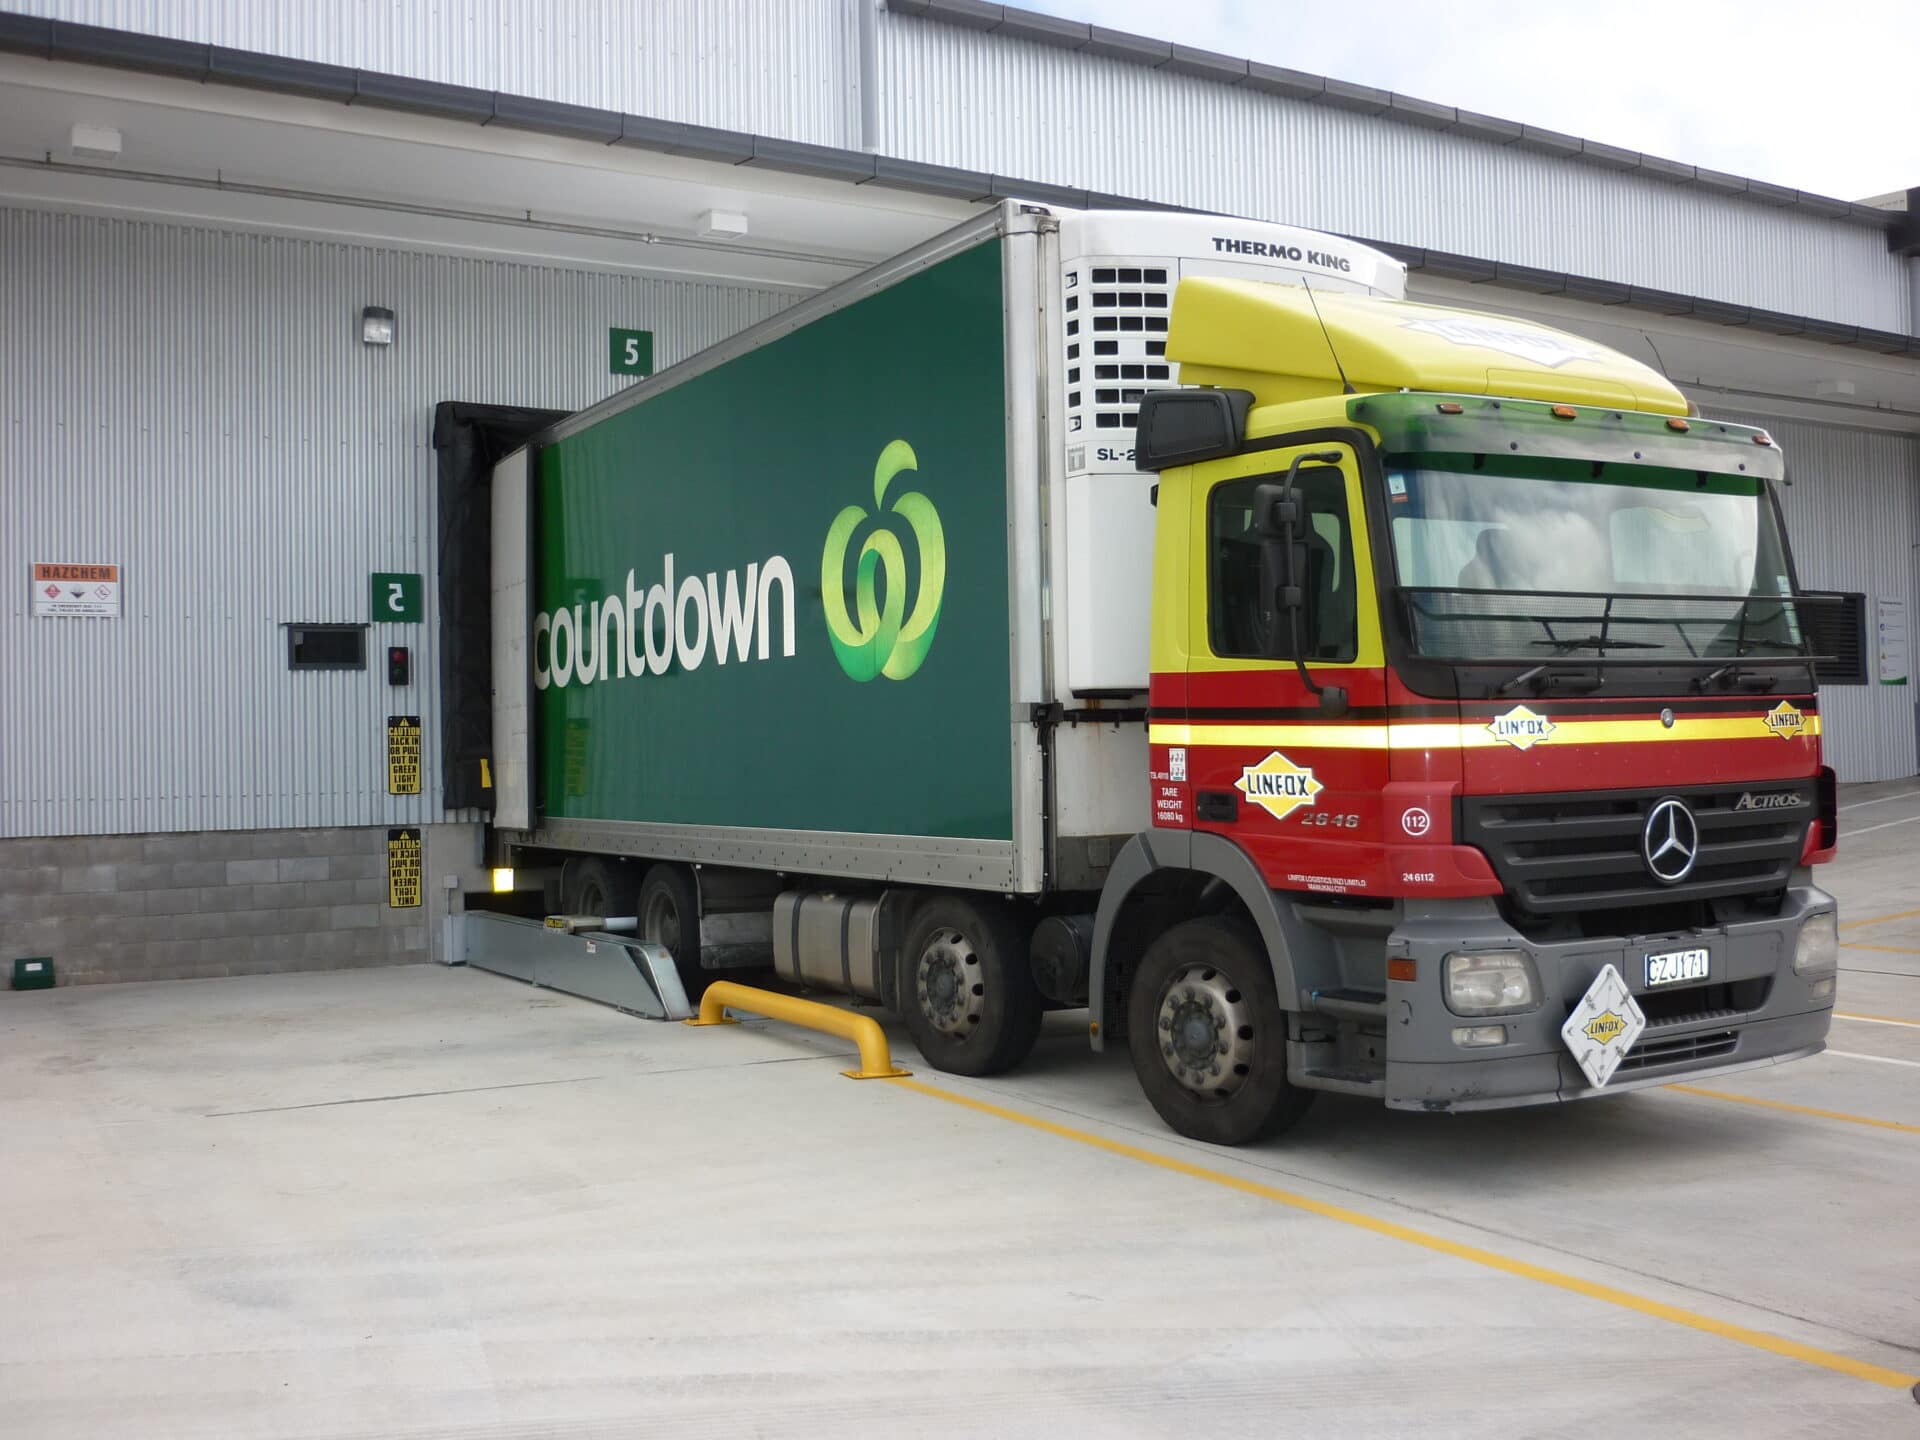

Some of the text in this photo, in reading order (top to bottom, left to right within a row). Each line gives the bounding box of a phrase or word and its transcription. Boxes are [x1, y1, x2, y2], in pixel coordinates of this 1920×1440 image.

[1211, 237, 1351, 272] THERMO KING
[624, 338, 640, 366] 5
[42, 566, 111, 580] HAZCHEM
[534, 553, 796, 690] countdown
[1771, 713, 1800, 727] LINFOX
[389, 727, 421, 735] CAUTION
[391, 736, 419, 745] BACK IN
[402, 746, 419, 755] PULL
[391, 756, 405, 764] OUT
[393, 765, 417, 774] GREEN
[394, 774, 416, 783] LIGHT
[396, 783, 414, 792] ONLY
[1247, 774, 1309, 796] LINFOX
[1161, 787, 1179, 797] TARE
[1157, 799, 1182, 809] WEIGHT
[1406, 815, 1426, 828] 112
[1590, 1020, 1620, 1034] LINFOX
